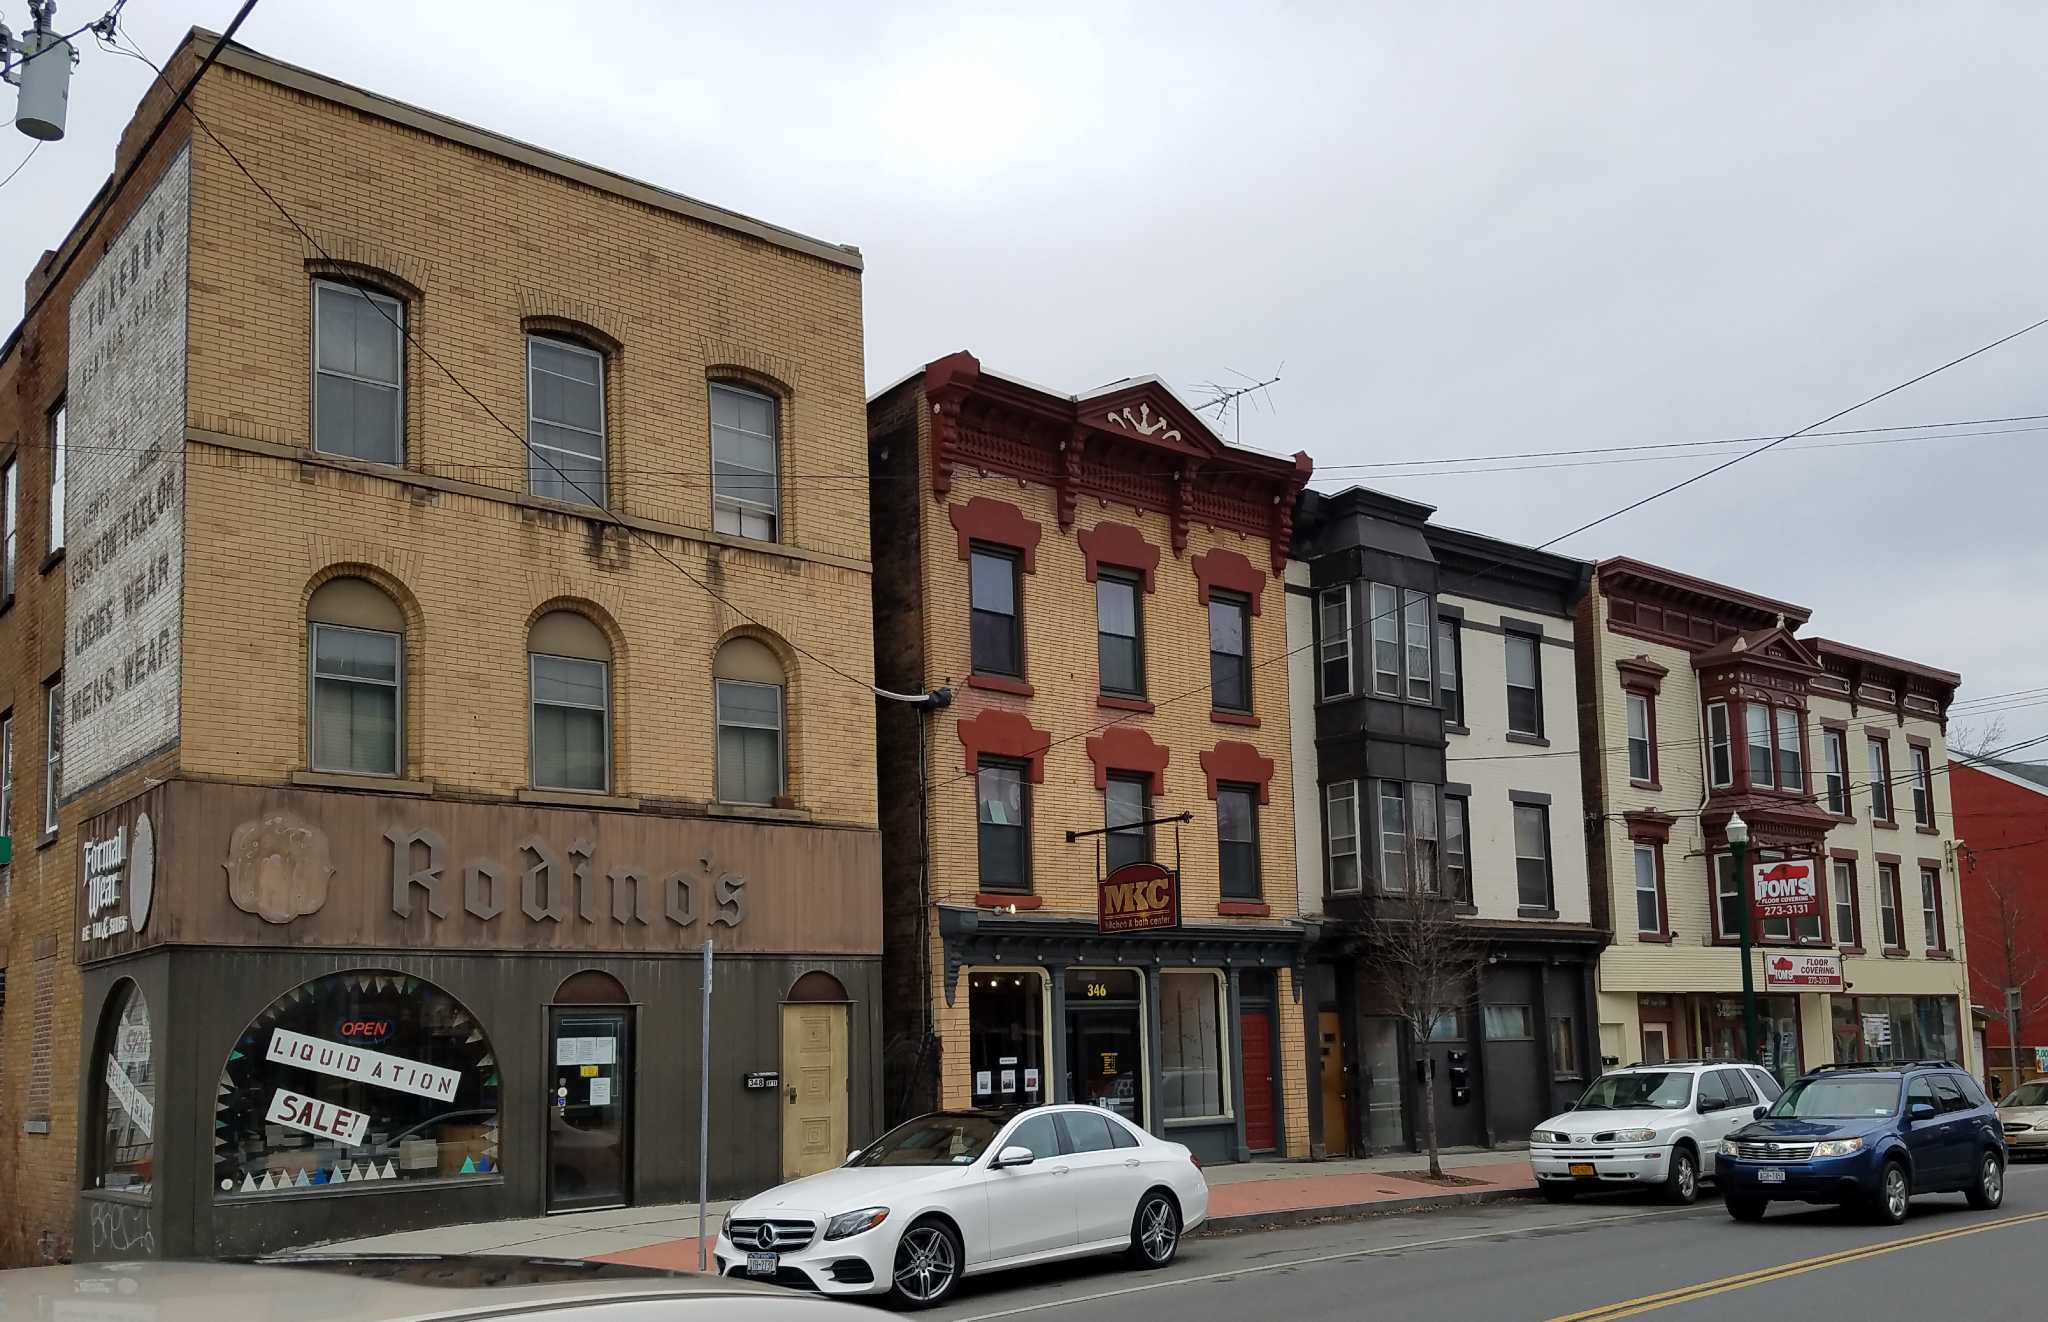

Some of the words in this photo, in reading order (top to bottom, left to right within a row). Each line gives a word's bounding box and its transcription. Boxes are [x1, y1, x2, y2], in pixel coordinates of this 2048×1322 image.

[88, 210, 164, 338] TUXEDOS
[72, 525, 117, 591] CUSTOM
[123, 472, 175, 546] TAILOR
[124, 552, 169, 620] WEAR
[124, 628, 170, 690] WEAR
[83, 826, 128, 888] Formal
[89, 871, 122, 919] Wear
[383, 827, 750, 929] Rodino's
[1758, 878, 1809, 898] TOM'S
[1104, 879, 1169, 913] MKC
[1764, 904, 1808, 916] 273-3131
[1780, 895, 1809, 903] COVERING
[1134, 917, 1149, 927] bath
[1800, 966, 1835, 975] COVERING
[1806, 958, 1829, 966] FLOOR
[1087, 983, 1107, 997] 346
[340, 1022, 388, 1037] OPEN
[272, 1036, 453, 1095] LIQUIDATION
[749, 1078, 764, 1088] 348
[277, 1095, 361, 1138] SALE!
